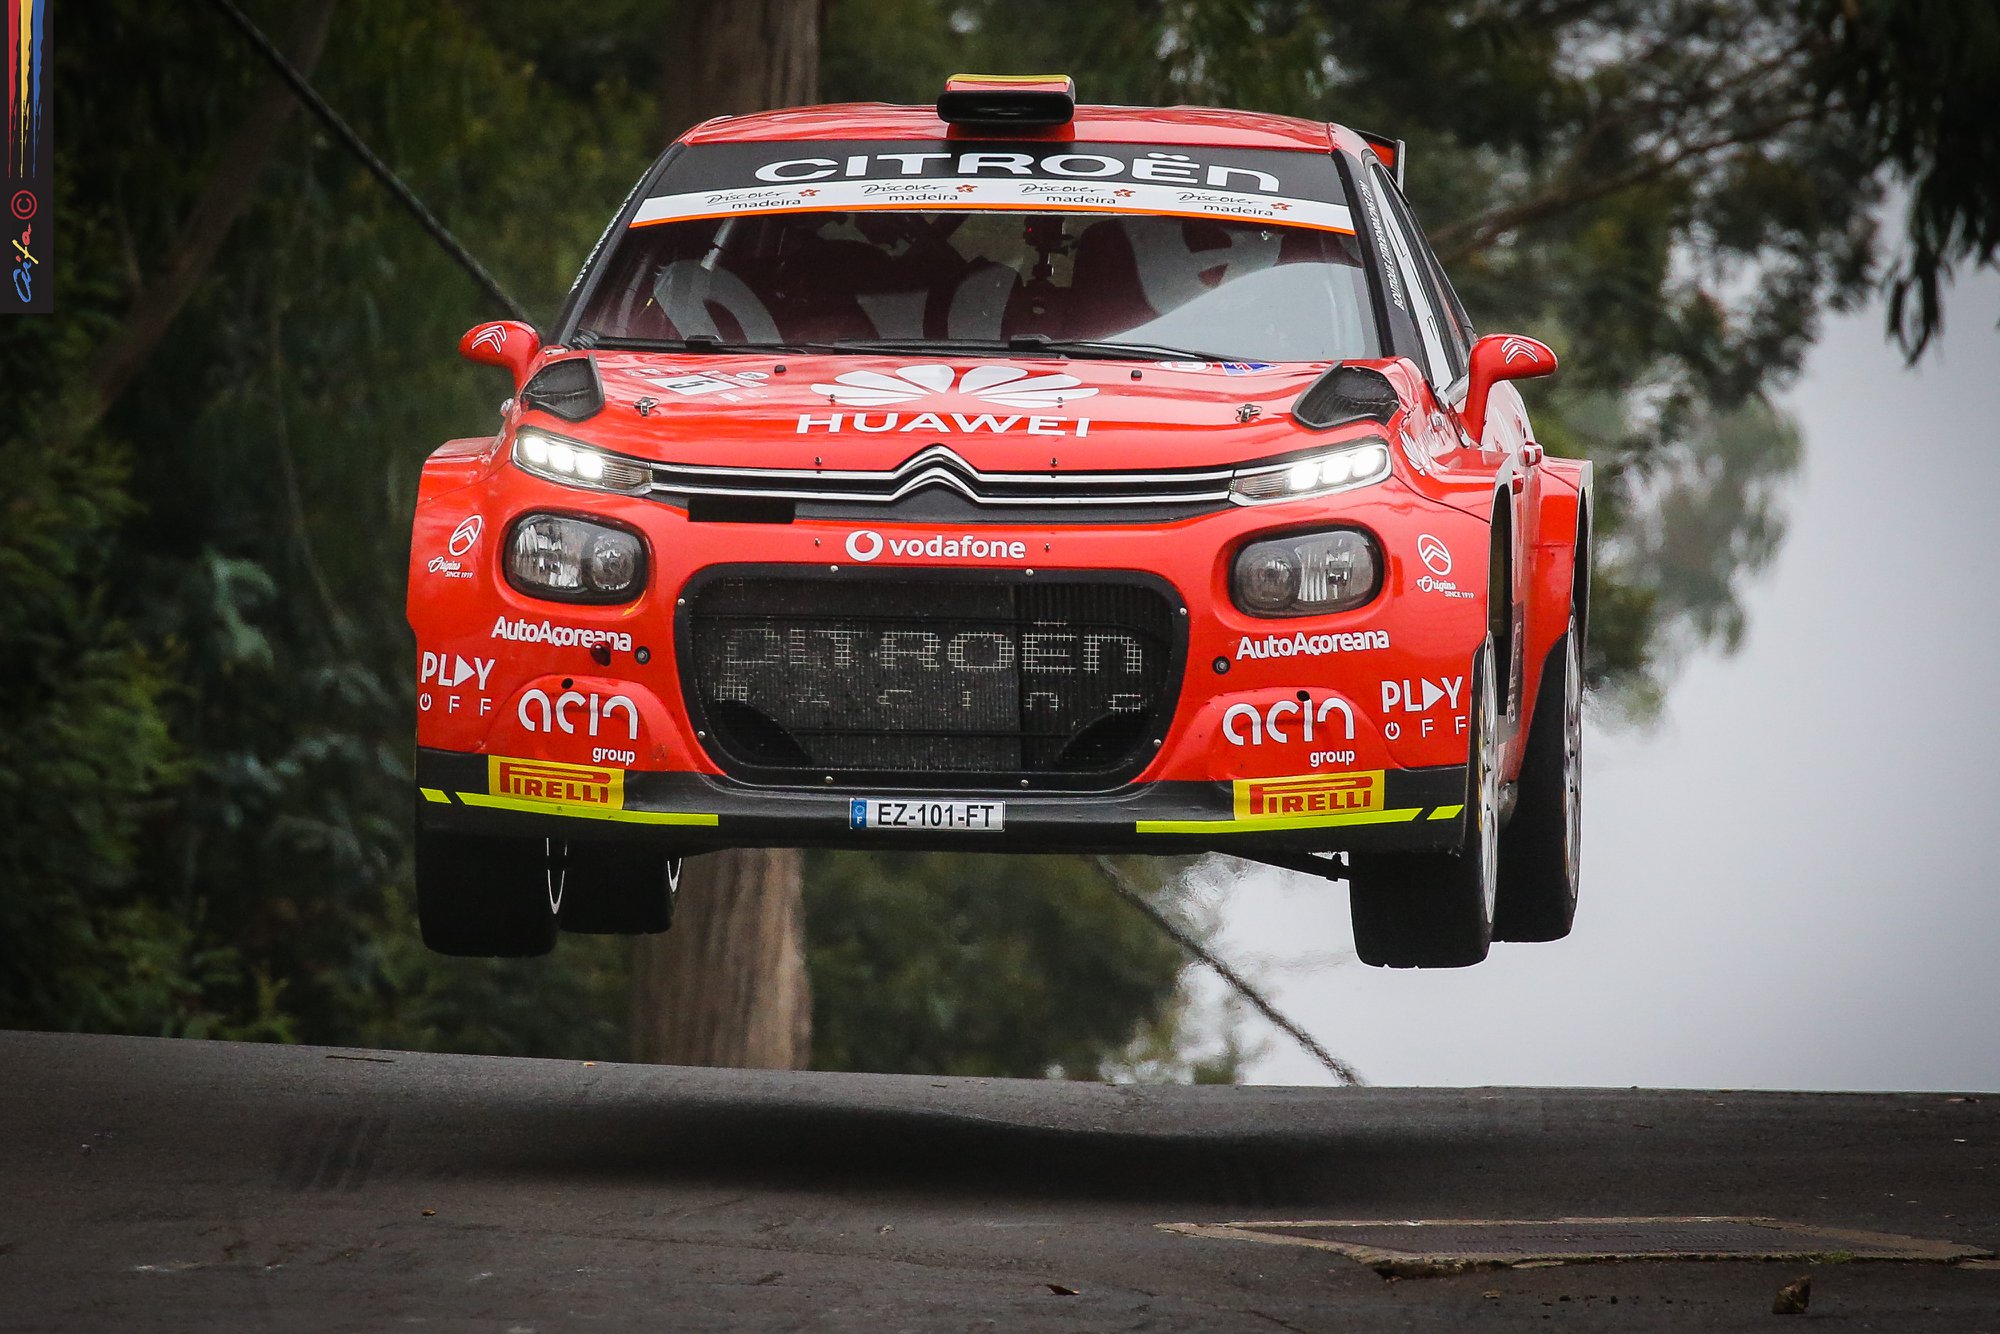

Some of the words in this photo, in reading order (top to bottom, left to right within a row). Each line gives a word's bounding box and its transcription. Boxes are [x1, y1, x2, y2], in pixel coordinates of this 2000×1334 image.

[862, 184, 949, 197] Discover
[1014, 183, 1106, 195] Discover
[705, 190, 791, 206] Discover
[732, 198, 801, 210] madeira
[889, 193, 958, 202] madeira
[1045, 195, 1116, 205] madeira
[1177, 192, 1266, 205] Discover
[1203, 204, 1274, 217] madeira
[796, 412, 1091, 438] HUAWEI
[888, 534, 1026, 560] vodafone
[1235, 630, 1390, 661] AutoAçoreana
[592, 747, 636, 764] group
[1309, 750, 1356, 768] group
[499, 761, 612, 804] PIRELLI
[1249, 776, 1374, 815] PIRELLI
[856, 816, 863, 825] F
[877, 803, 995, 828] EZ-101-FT
